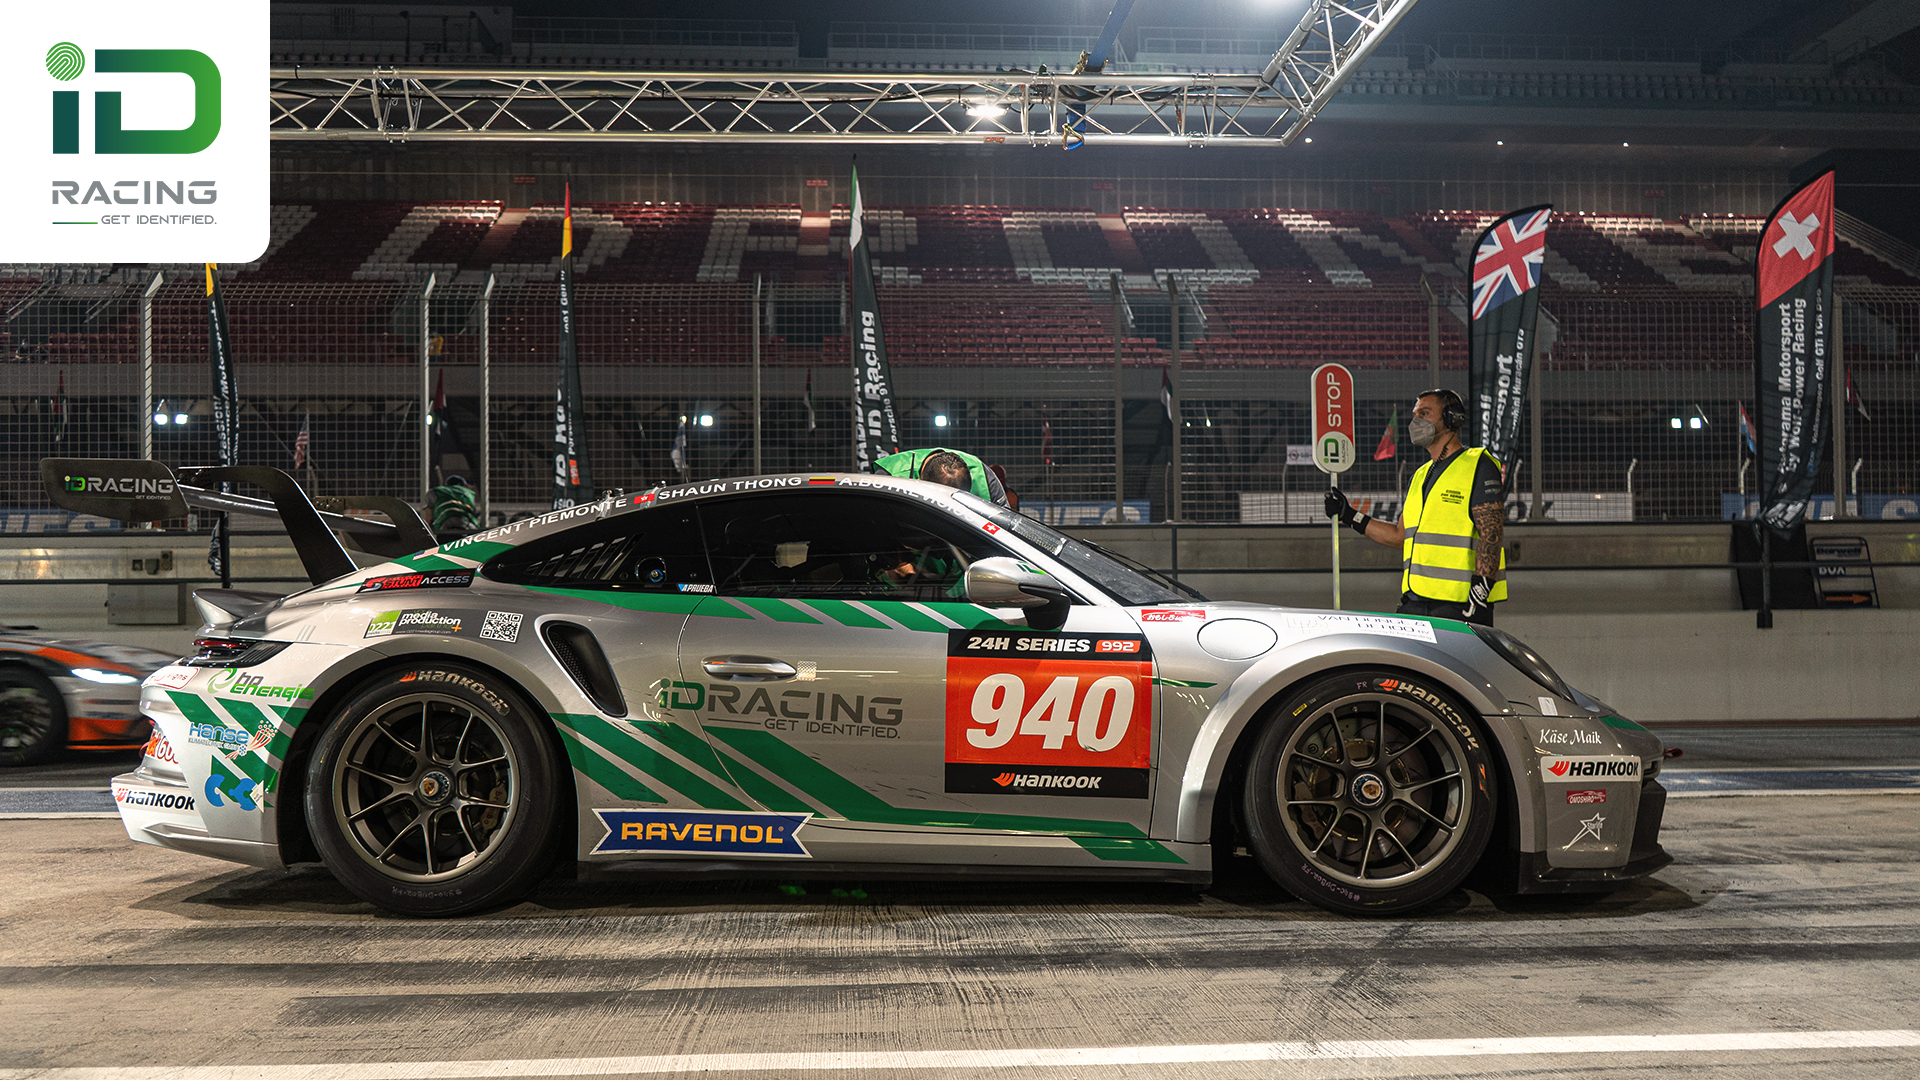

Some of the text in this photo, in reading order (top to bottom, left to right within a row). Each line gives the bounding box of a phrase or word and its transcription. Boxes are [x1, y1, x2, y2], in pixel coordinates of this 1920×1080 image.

[860, 311, 882, 401] Racing
[1779, 302, 1793, 391] Motorsport
[1815, 339, 1824, 355] GTI
[1815, 360, 1825, 381] Golf
[1786, 298, 1807, 472] by Wolf-Power Racing
[1327, 372, 1342, 427] STOP
[868, 409, 882, 437] ID
[883, 398, 898, 442] Porsche
[658, 474, 803, 500] SHAUN THONG
[443, 522, 524, 552] VINCENT
[529, 500, 627, 528] PIEMONTE
[384, 575, 470, 588] STUNT ACCESS
[399, 617, 461, 627] production
[401, 611, 439, 620] media
[967, 637, 1135, 652] 24H SERIES 992
[418, 670, 511, 717] HANKOOK
[966, 673, 1135, 753] 940
[1397, 681, 1480, 751] HANKOOK
[764, 718, 900, 739] GET IDENTIFIED.
[1539, 729, 1602, 745] Käse Maik
[1569, 761, 1638, 776] HANKOOK
[1013, 774, 1102, 789] HANKOOK
[126, 790, 195, 810] HANKOOK
[483, 789, 503, 826] brmbo
[620, 822, 784, 844] RAVENOL
